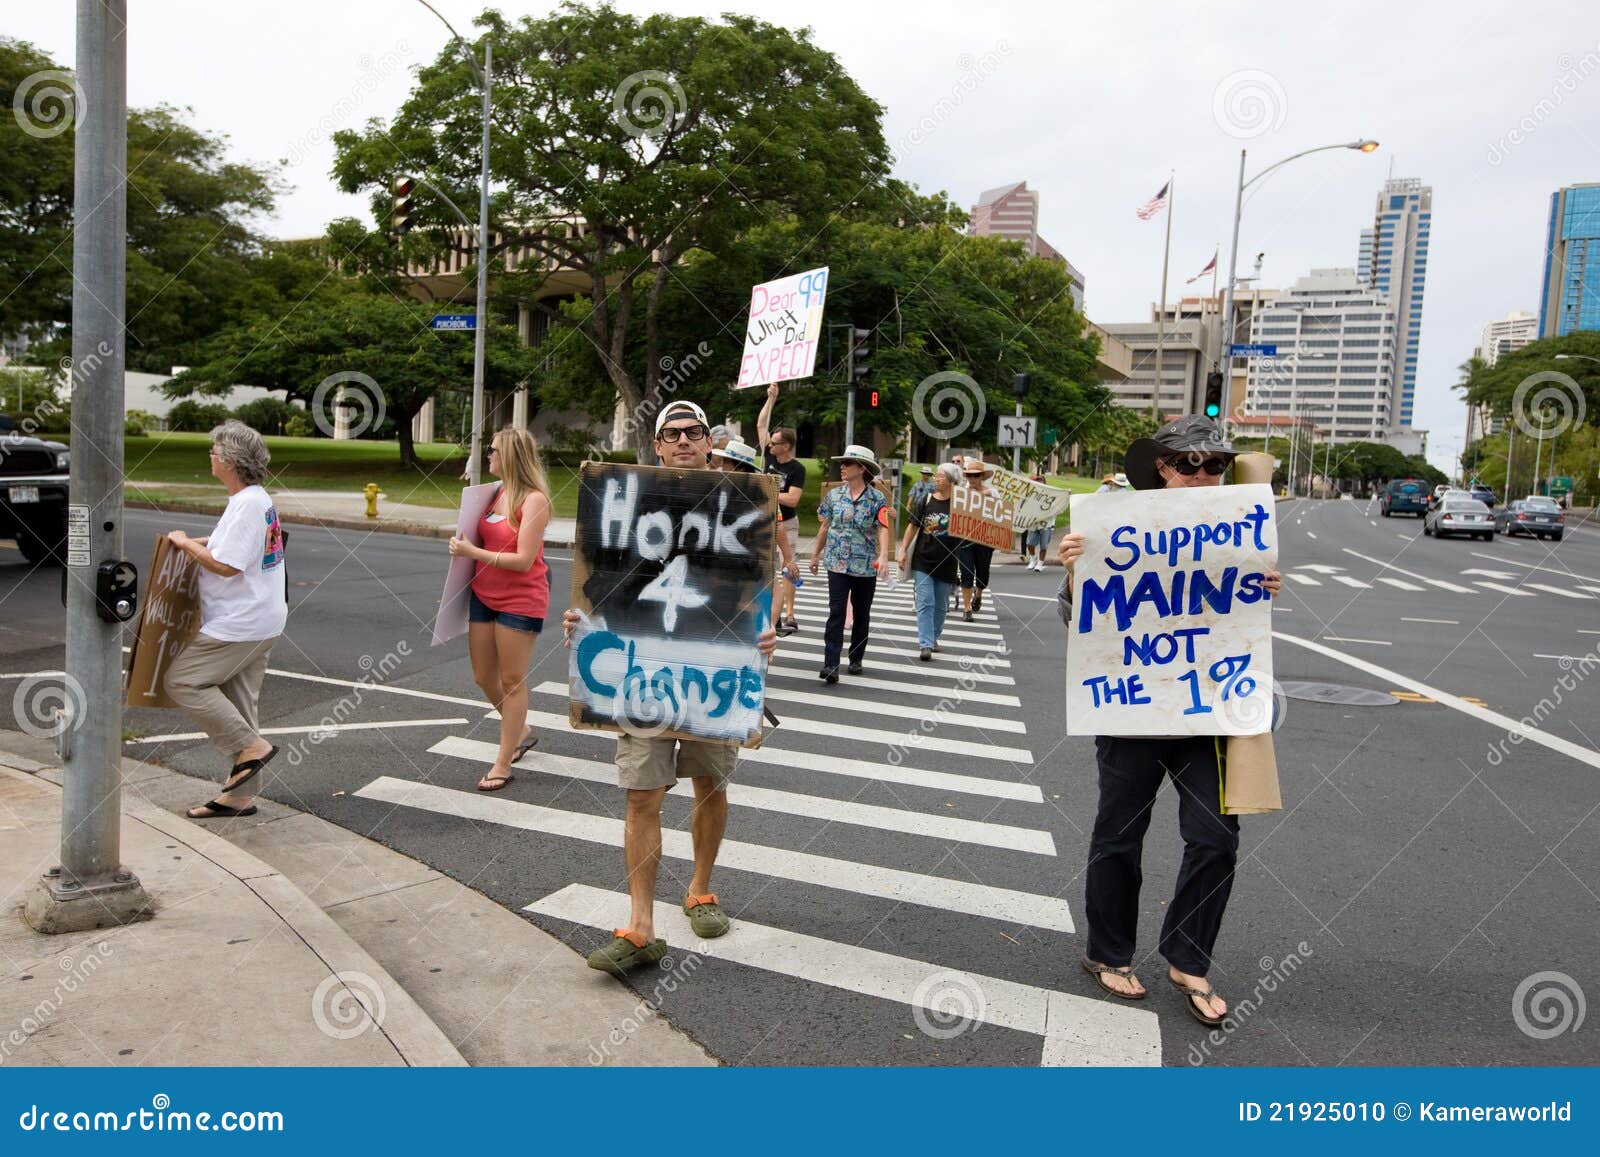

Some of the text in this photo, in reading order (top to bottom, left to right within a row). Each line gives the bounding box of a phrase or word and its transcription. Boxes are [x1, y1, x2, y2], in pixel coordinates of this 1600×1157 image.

[751, 287, 797, 318] Dear
[748, 310, 798, 346] What
[784, 322, 807, 345] Did
[739, 340, 814, 387] EXPECT
[601, 472, 762, 561] Honk
[1104, 505, 1270, 571] Support
[145, 592, 175, 627] WALL
[638, 555, 711, 632] 4
[1123, 628, 1210, 666] NOT
[577, 631, 762, 718] Change
[1082, 654, 1256, 714] THE 1%
